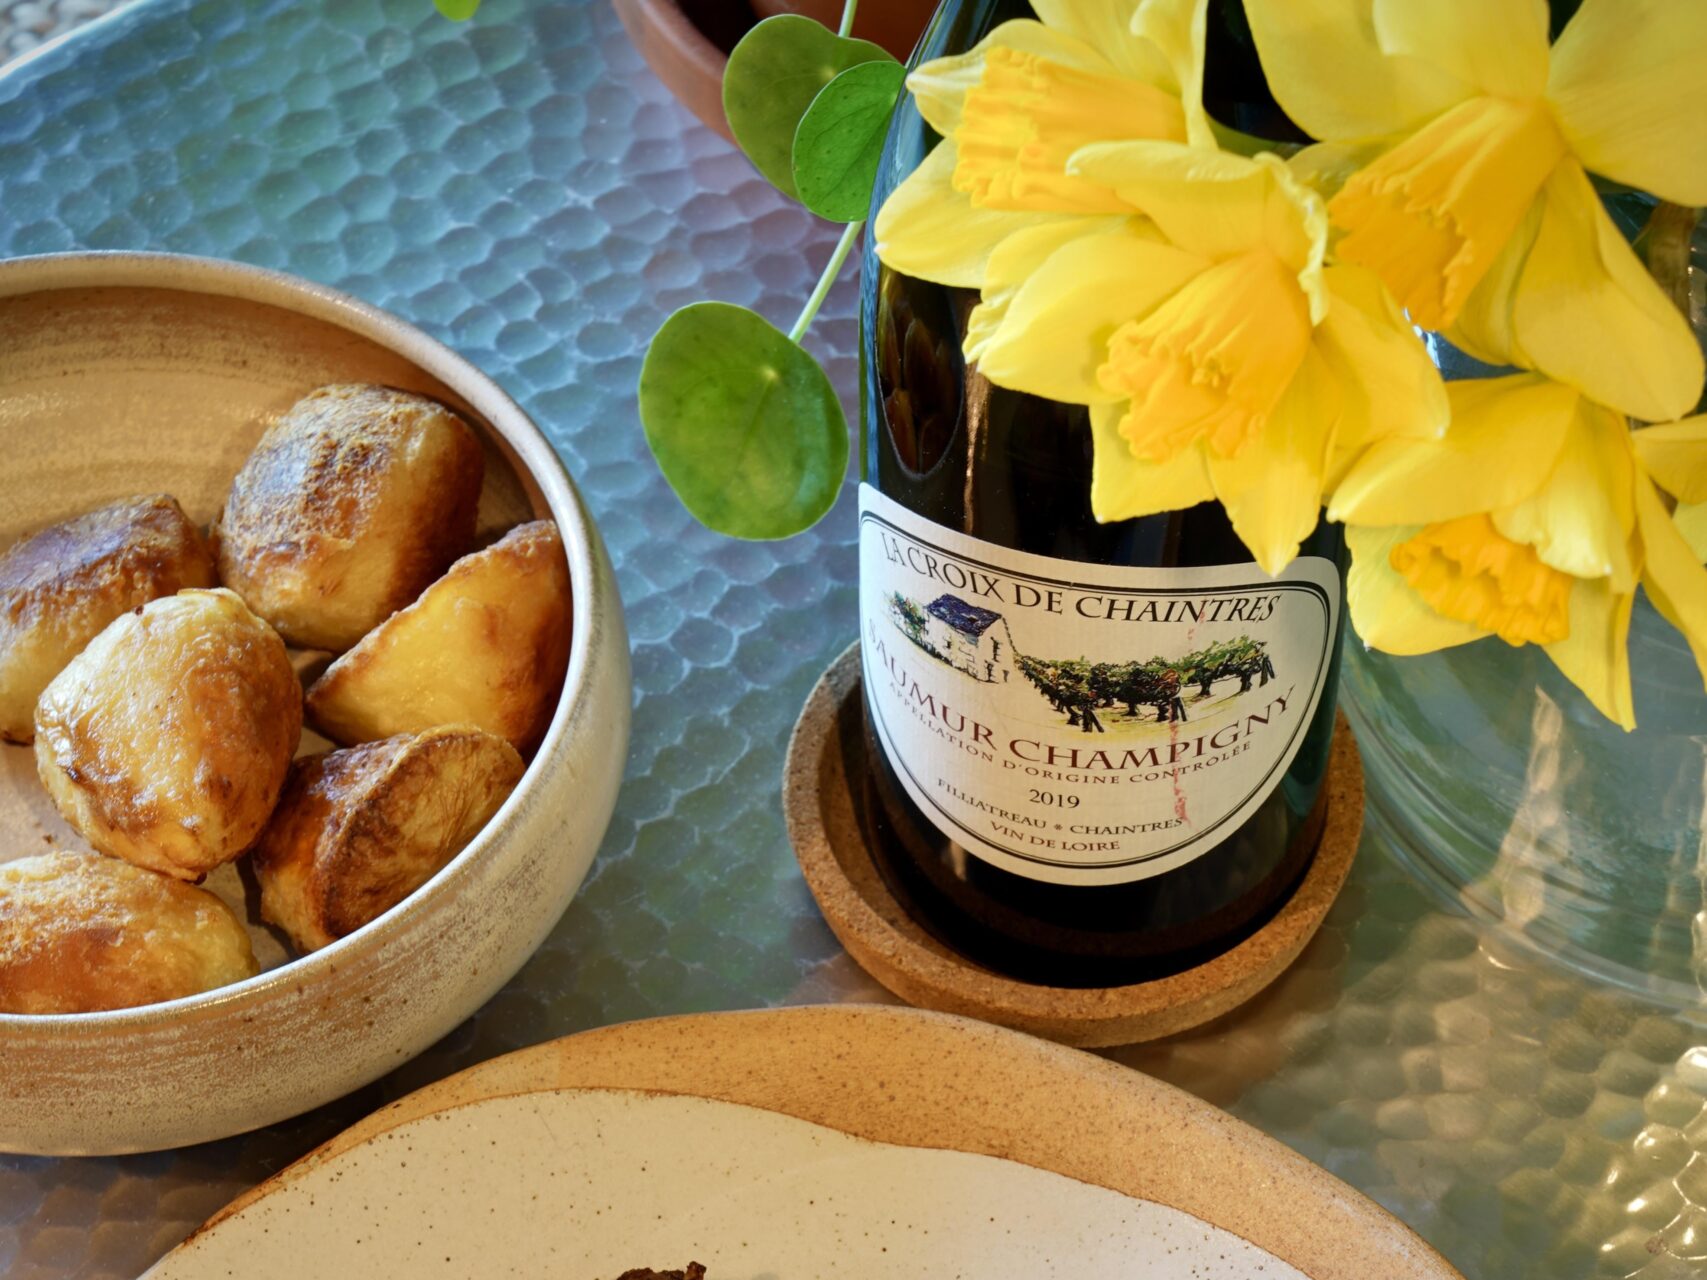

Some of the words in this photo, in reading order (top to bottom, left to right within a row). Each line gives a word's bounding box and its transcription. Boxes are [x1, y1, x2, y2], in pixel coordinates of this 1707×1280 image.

[881, 532, 906, 580] LA
[906, 547, 1004, 602] CROIX
[1012, 584, 1063, 614] DE
[1075, 594, 1281, 623] CHAINTRES
[869, 619, 996, 749] SAUMUR
[1009, 685, 1296, 770] CHAMPIGNY
[888, 679, 994, 762] APPELLATION
[1003, 758, 1120, 784] D'ORIGINE
[938, 778, 1047, 829] FILLIATREAU
[1070, 817, 1184, 835] CHAINTRES
[990, 821, 1025, 844] VIN
[1030, 836, 1057, 850] DE
[1061, 839, 1121, 851] LOIRE
[1029, 789, 1080, 809] 2019
